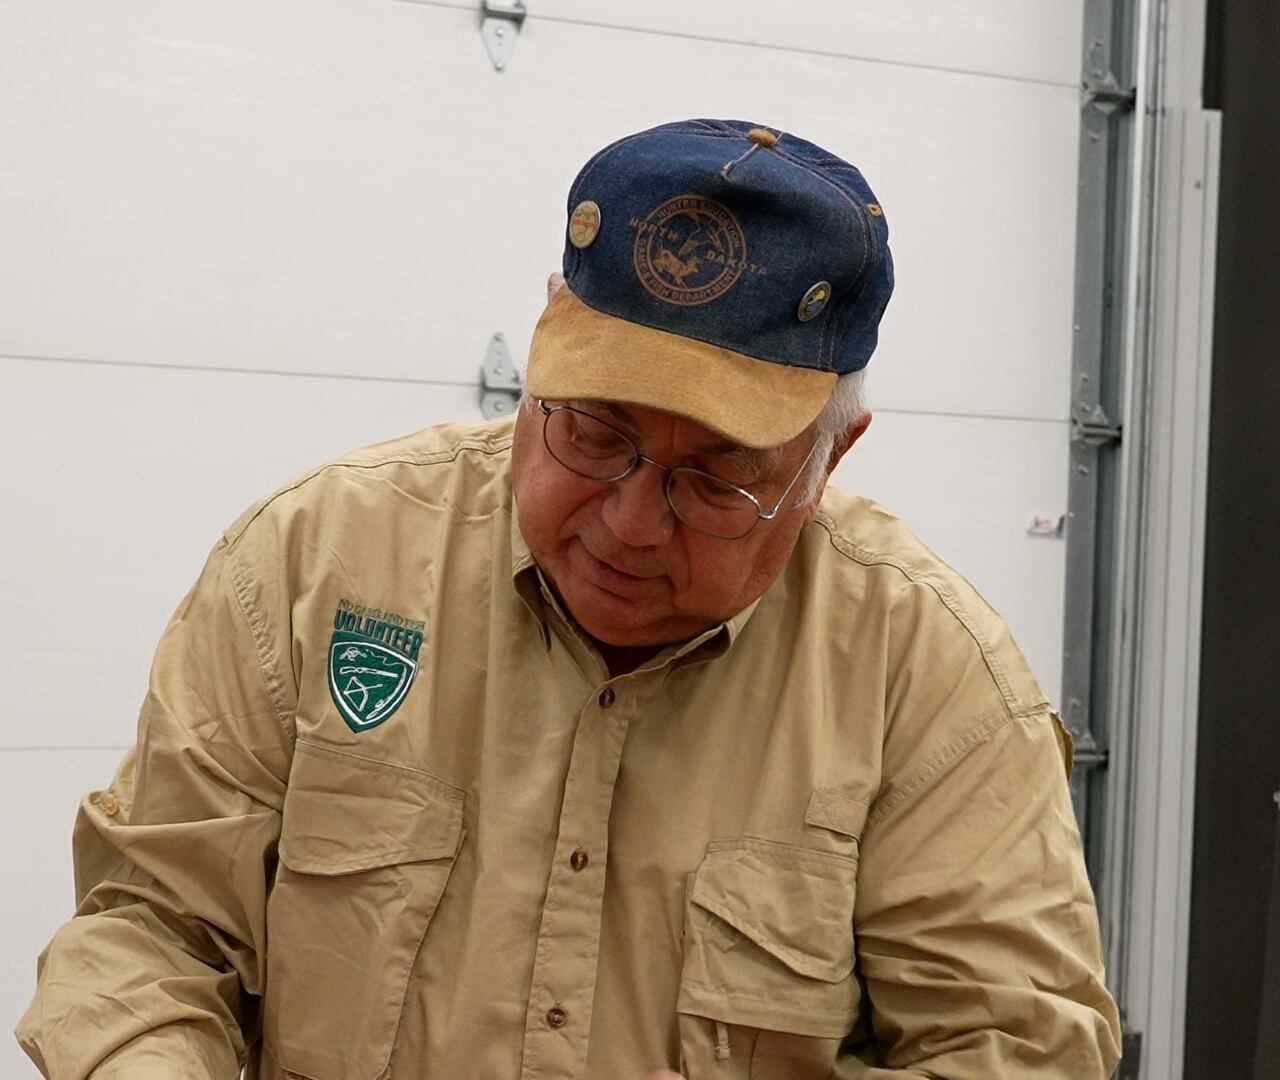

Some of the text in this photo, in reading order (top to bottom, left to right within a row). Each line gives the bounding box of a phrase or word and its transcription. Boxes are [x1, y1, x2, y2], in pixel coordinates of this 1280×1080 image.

[628, 217, 678, 241] NORTH
[707, 250, 767, 275] DAKOTA
[334, 608, 424, 662] VOLUNTEER
